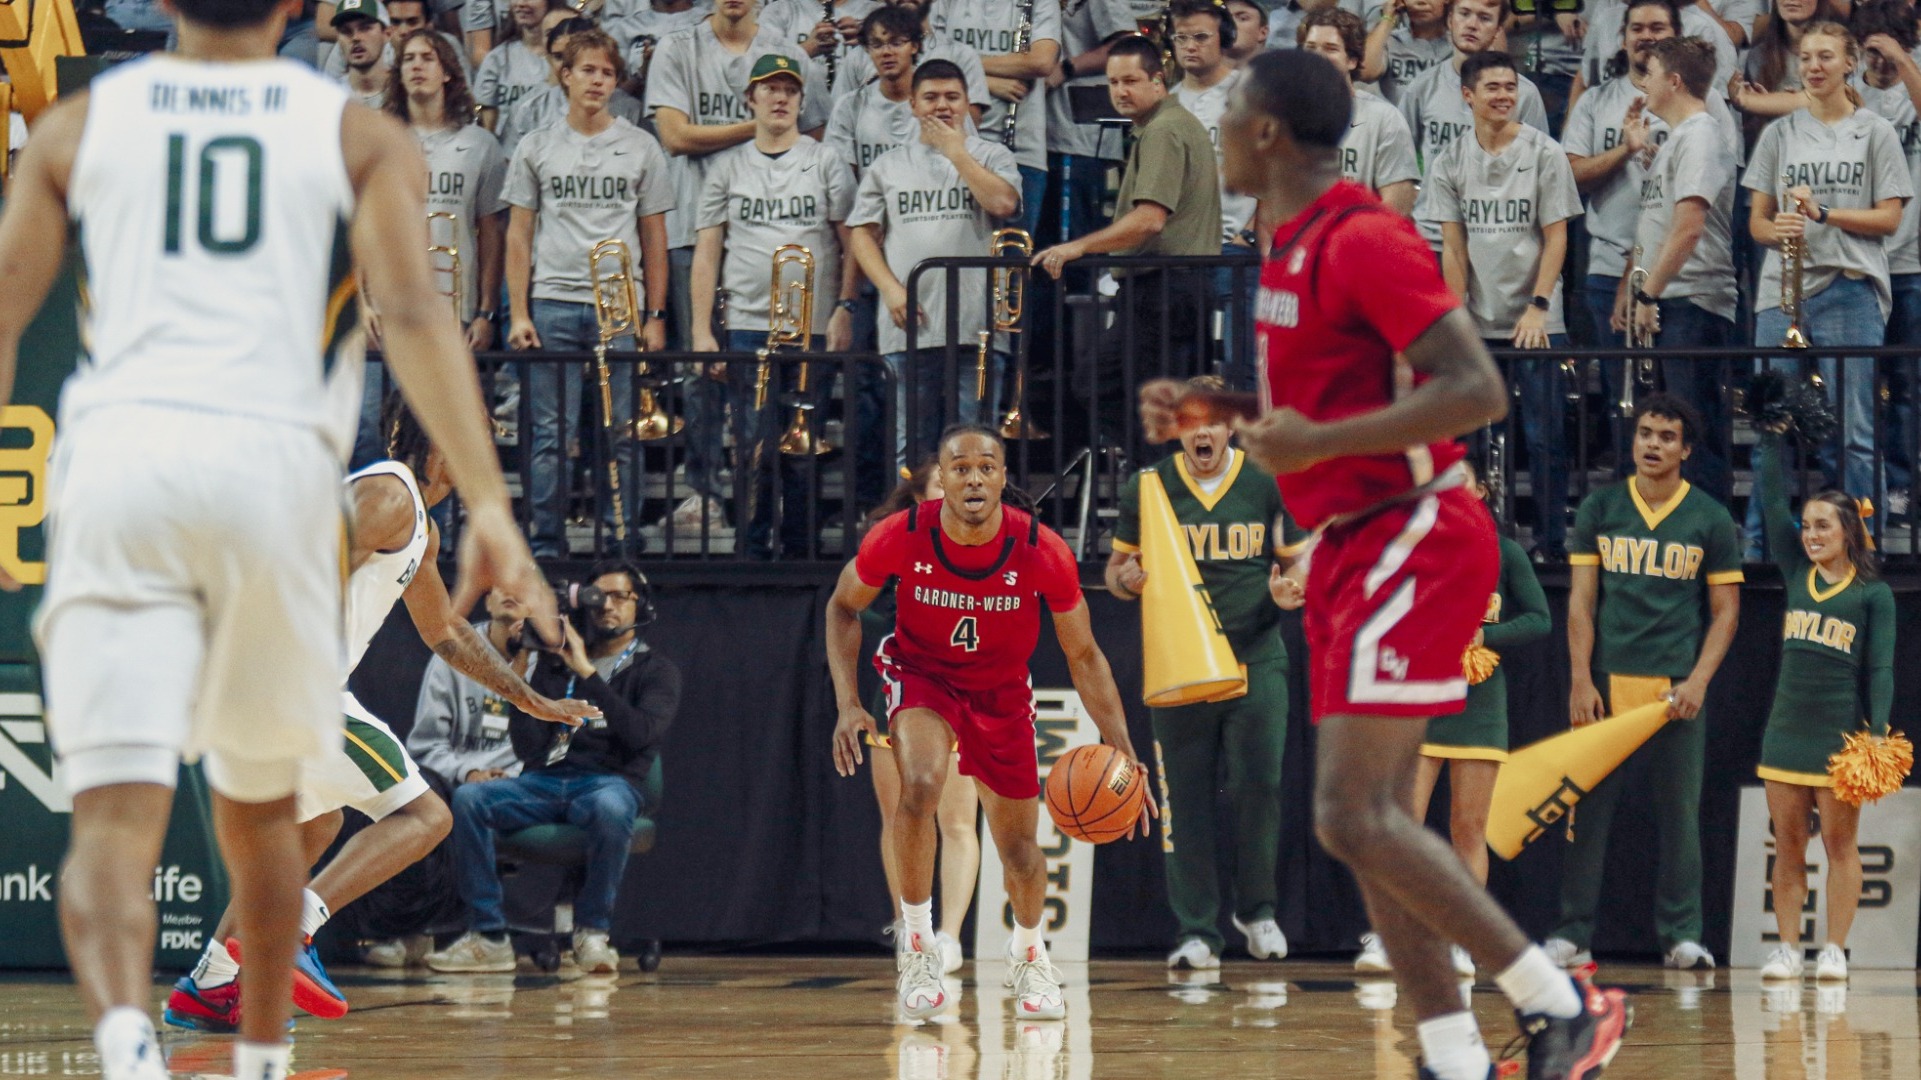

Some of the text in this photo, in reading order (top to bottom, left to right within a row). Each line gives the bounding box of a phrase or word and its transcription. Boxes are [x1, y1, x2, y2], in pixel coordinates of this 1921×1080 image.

[953, 28, 1018, 52] BAYLO
[699, 92, 746, 119] BAYL
[164, 132, 263, 254] 10
[428, 171, 465, 196] LOR
[551, 175, 628, 200] BAYLOR
[740, 194, 816, 221] BAYLOR
[898, 187, 974, 215] BAYLOR
[1597, 536, 1704, 580] BAYLOR
[914, 586, 1020, 611] GARDNER-WEBB
[950, 616, 979, 652] 4
[0, 865, 202, 902] nk ife
[163, 914, 202, 926] Member
[161, 931, 203, 950] FDIC
